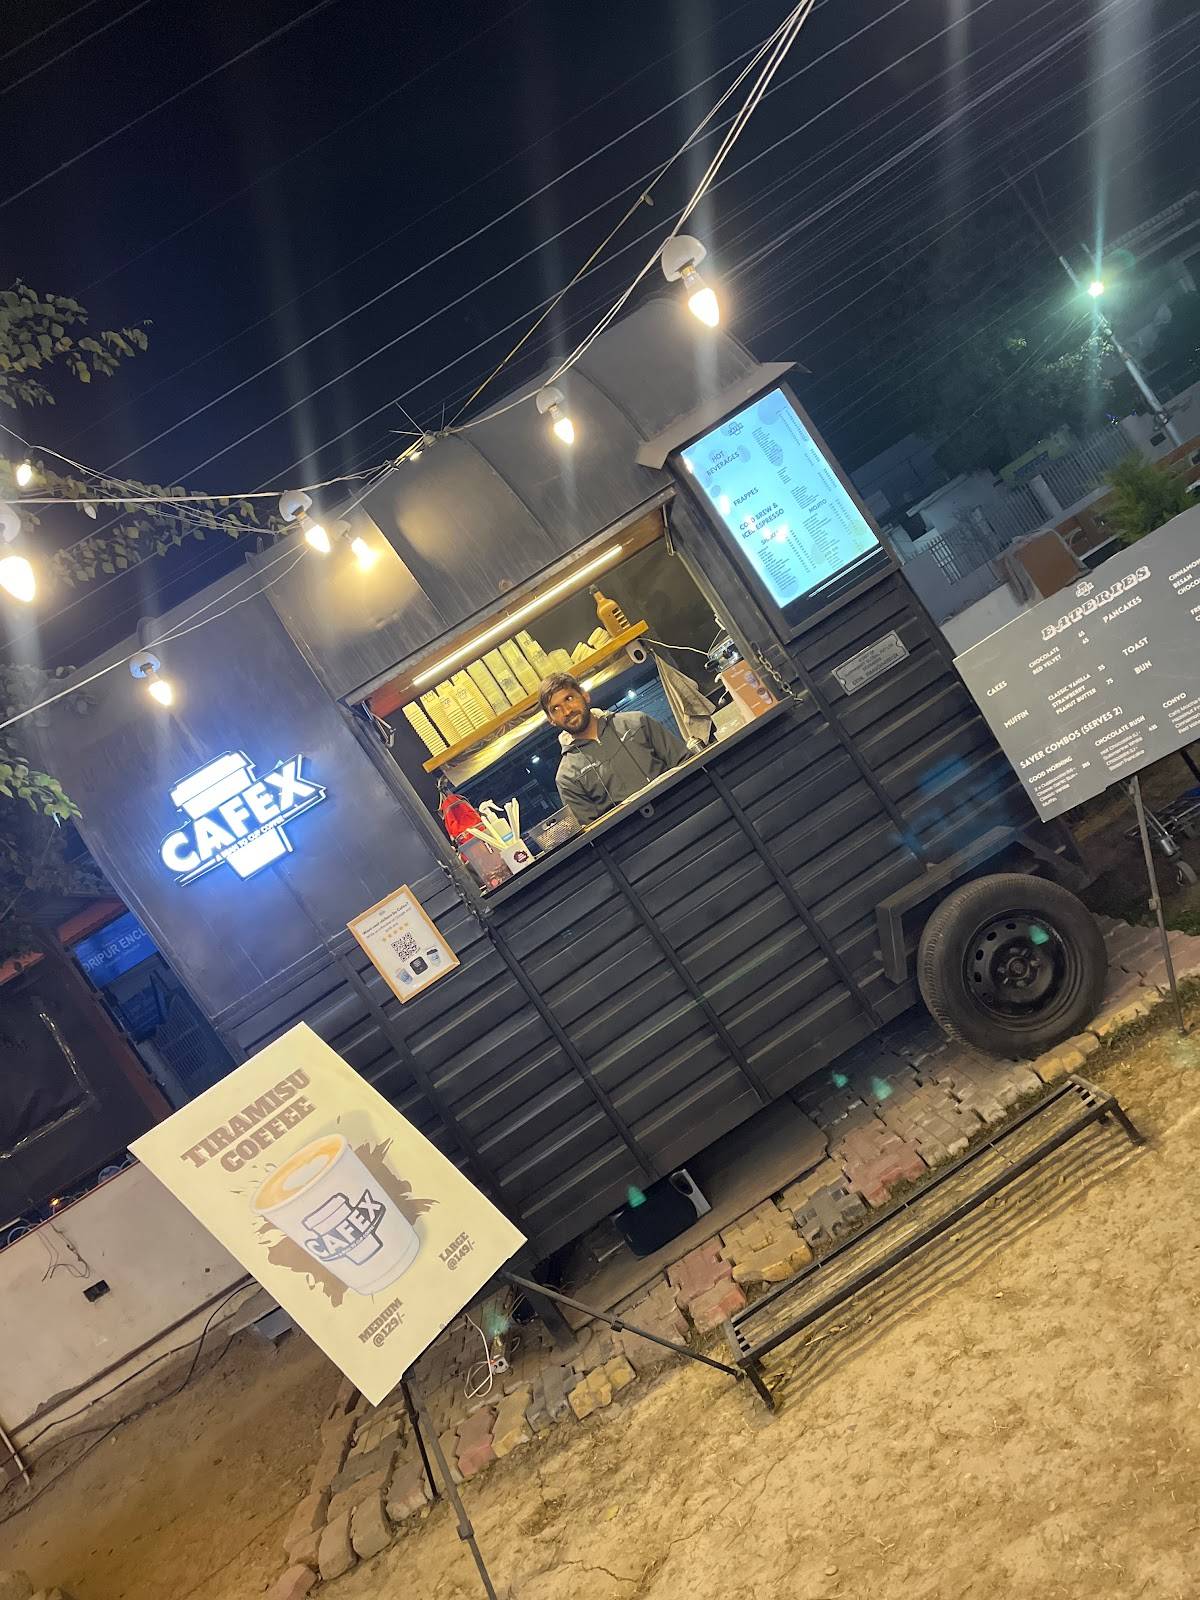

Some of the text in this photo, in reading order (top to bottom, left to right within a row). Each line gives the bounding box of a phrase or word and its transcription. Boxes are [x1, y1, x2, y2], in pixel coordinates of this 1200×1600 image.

[712, 451, 725, 462] HOT
[733, 487, 759, 506] FRAPPES
[740, 517, 755, 530] COD
[1178, 578, 1200, 594] CHOCO
[1041, 566, 1150, 641] EATERIES
[1102, 596, 1142, 624] PANCAKES
[1029, 646, 1060, 668] CHOCOLATE
[1122, 637, 1149, 656] TOAST
[1042, 654, 1062, 671] VELVET
[1134, 660, 1152, 674] BUN
[987, 680, 1008, 697] CAKES
[1048, 684, 1070, 701] CLASSIC
[1067, 673, 1092, 692] VANILLA
[1052, 686, 1086, 708] STRAWBERRY
[1056, 699, 1077, 715] PEANUT
[1074, 688, 1097, 704] BUTTER
[1004, 710, 1029, 729] MUFFIN
[1094, 715, 1146, 746] CHOCOLATE RUSH
[1020, 706, 1123, 769] SAVER COMBOS (SERVES 2)
[1029, 756, 1073, 784] GOOD MORNING
[162, 762, 315, 872] CAFEX
[180, 1068, 311, 1170] TIRAMISU
[219, 1095, 317, 1173] COFFEE
[304, 1189, 384, 1260] CAFEX
[438, 1231, 470, 1263] LARGE
[447, 1239, 476, 1271] @149/-
[358, 1297, 403, 1344] MEDIUM
[372, 1313, 406, 1348] @129/-
